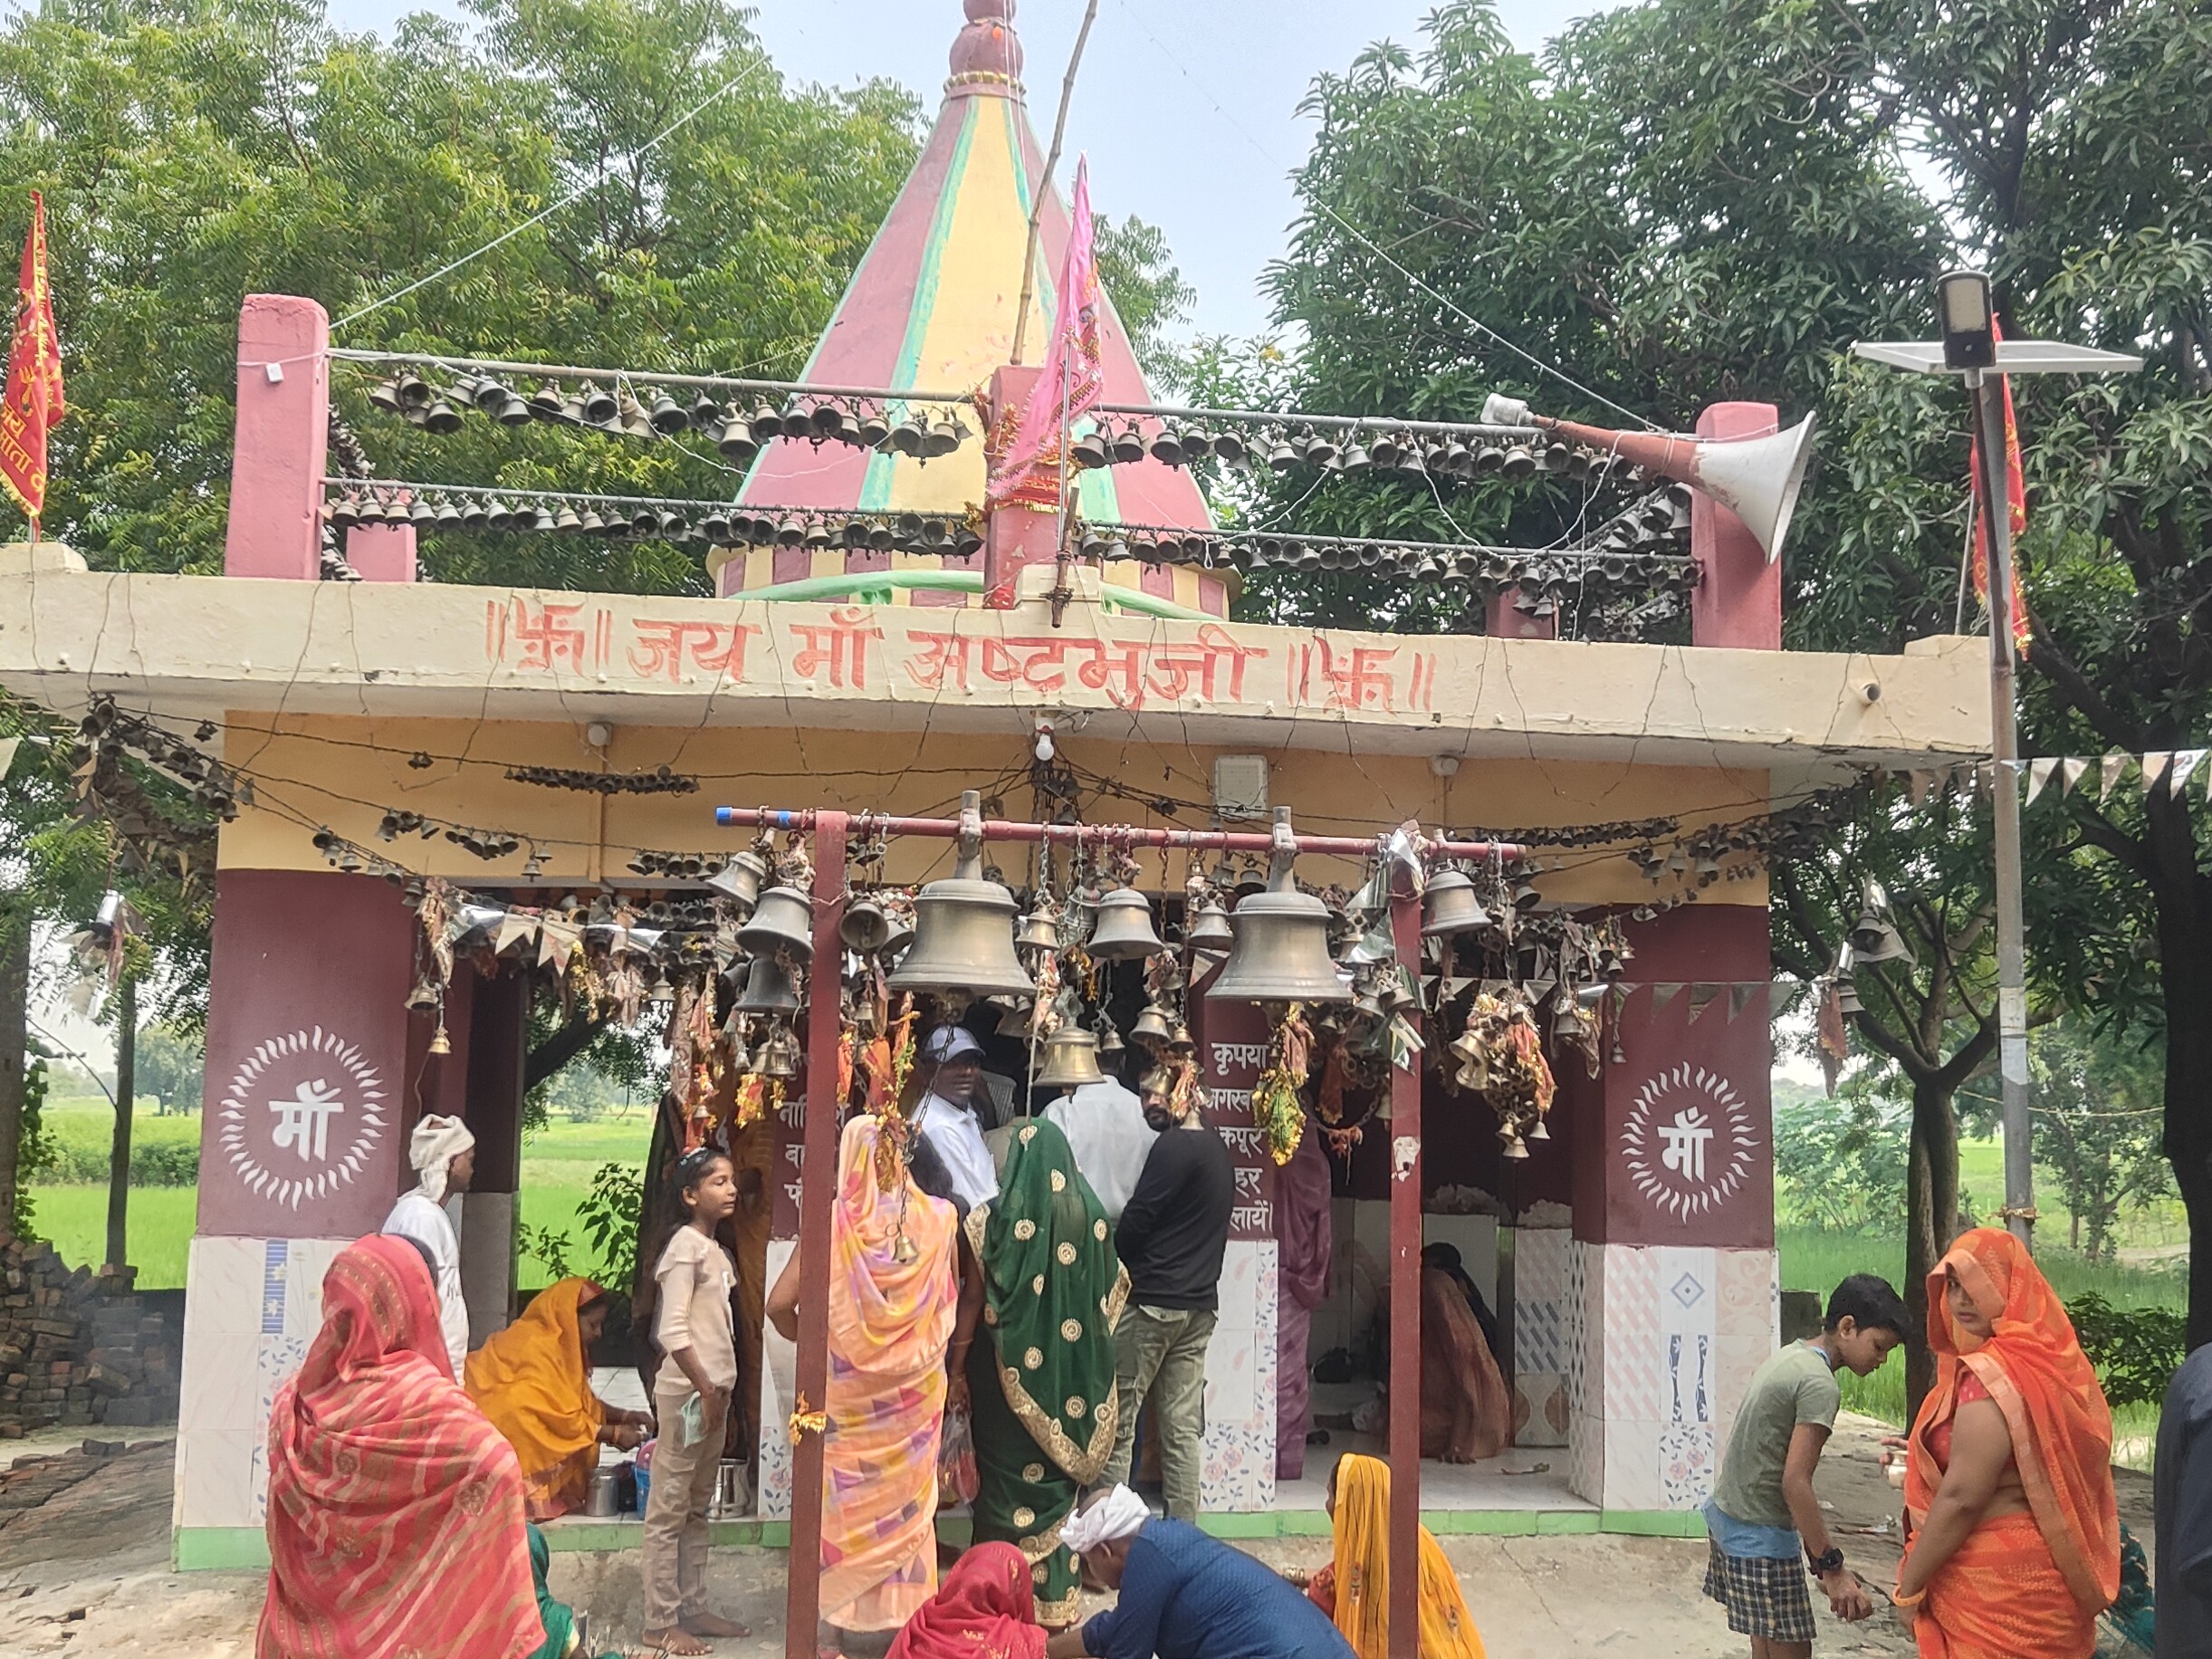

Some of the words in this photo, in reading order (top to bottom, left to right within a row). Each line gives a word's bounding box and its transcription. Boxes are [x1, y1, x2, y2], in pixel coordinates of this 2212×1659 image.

[626, 618, 763, 685] जय
[789, 607, 886, 691] माँ
[904, 623, 1269, 711] अष्टभुजी
[1211, 1041, 1269, 1076] कृपया
[1205, 1088, 1253, 1113] अगरब
[268, 1078, 345, 1163] माँ
[1657, 1106, 1714, 1183] माँ
[1233, 1166, 1264, 1199] हर
[1230, 1199, 1273, 1233] लायें।
